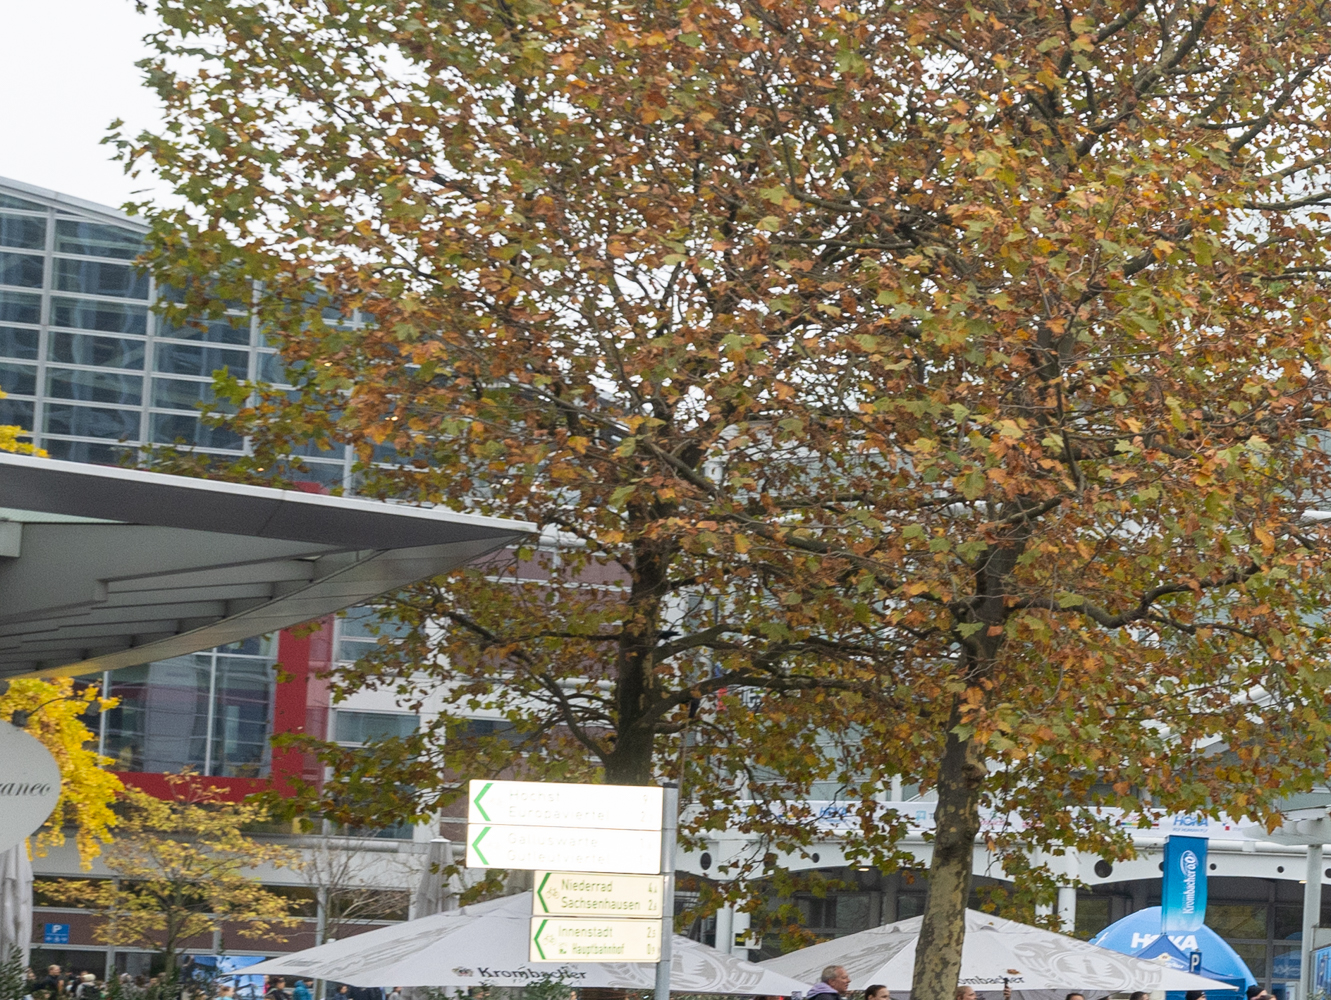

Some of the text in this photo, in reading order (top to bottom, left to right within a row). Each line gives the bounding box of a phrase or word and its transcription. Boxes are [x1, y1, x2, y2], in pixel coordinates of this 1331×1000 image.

[561, 878, 613, 892] Niederrad
[561, 896, 640, 910] Sachsenhausen
[558, 925, 613, 938] Innenstadt
[1191, 954, 1200, 971] P
